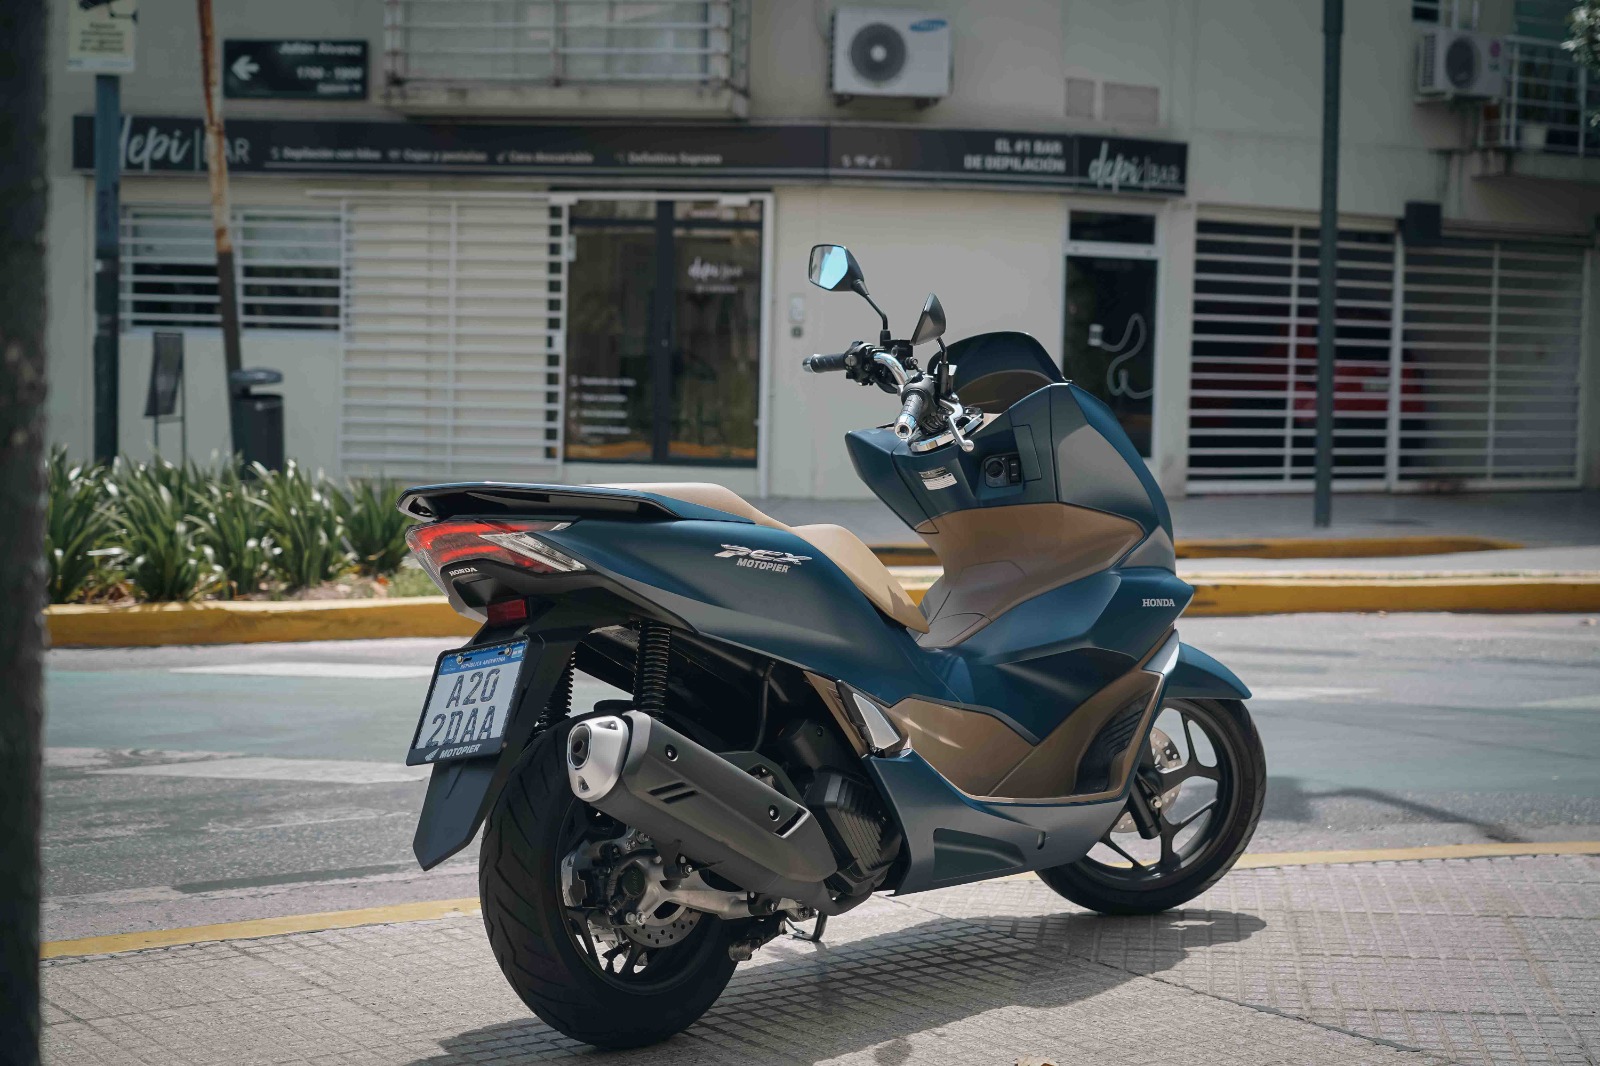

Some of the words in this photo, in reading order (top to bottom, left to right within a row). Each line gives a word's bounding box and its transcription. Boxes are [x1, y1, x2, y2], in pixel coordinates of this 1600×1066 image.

[994, 138, 1011, 154] EL
[1033, 141, 1063, 156] BAR
[963, 154, 981, 169] DE
[984, 155, 1066, 173] DEPILACIÓN
[449, 567, 478, 577] HONDA
[736, 558, 789, 573] MOTOPIER
[1142, 598, 1176, 607] HONDA
[445, 668, 500, 708] A20
[425, 705, 496, 748] 2DAA
[439, 743, 482, 759] MOTOPIER
